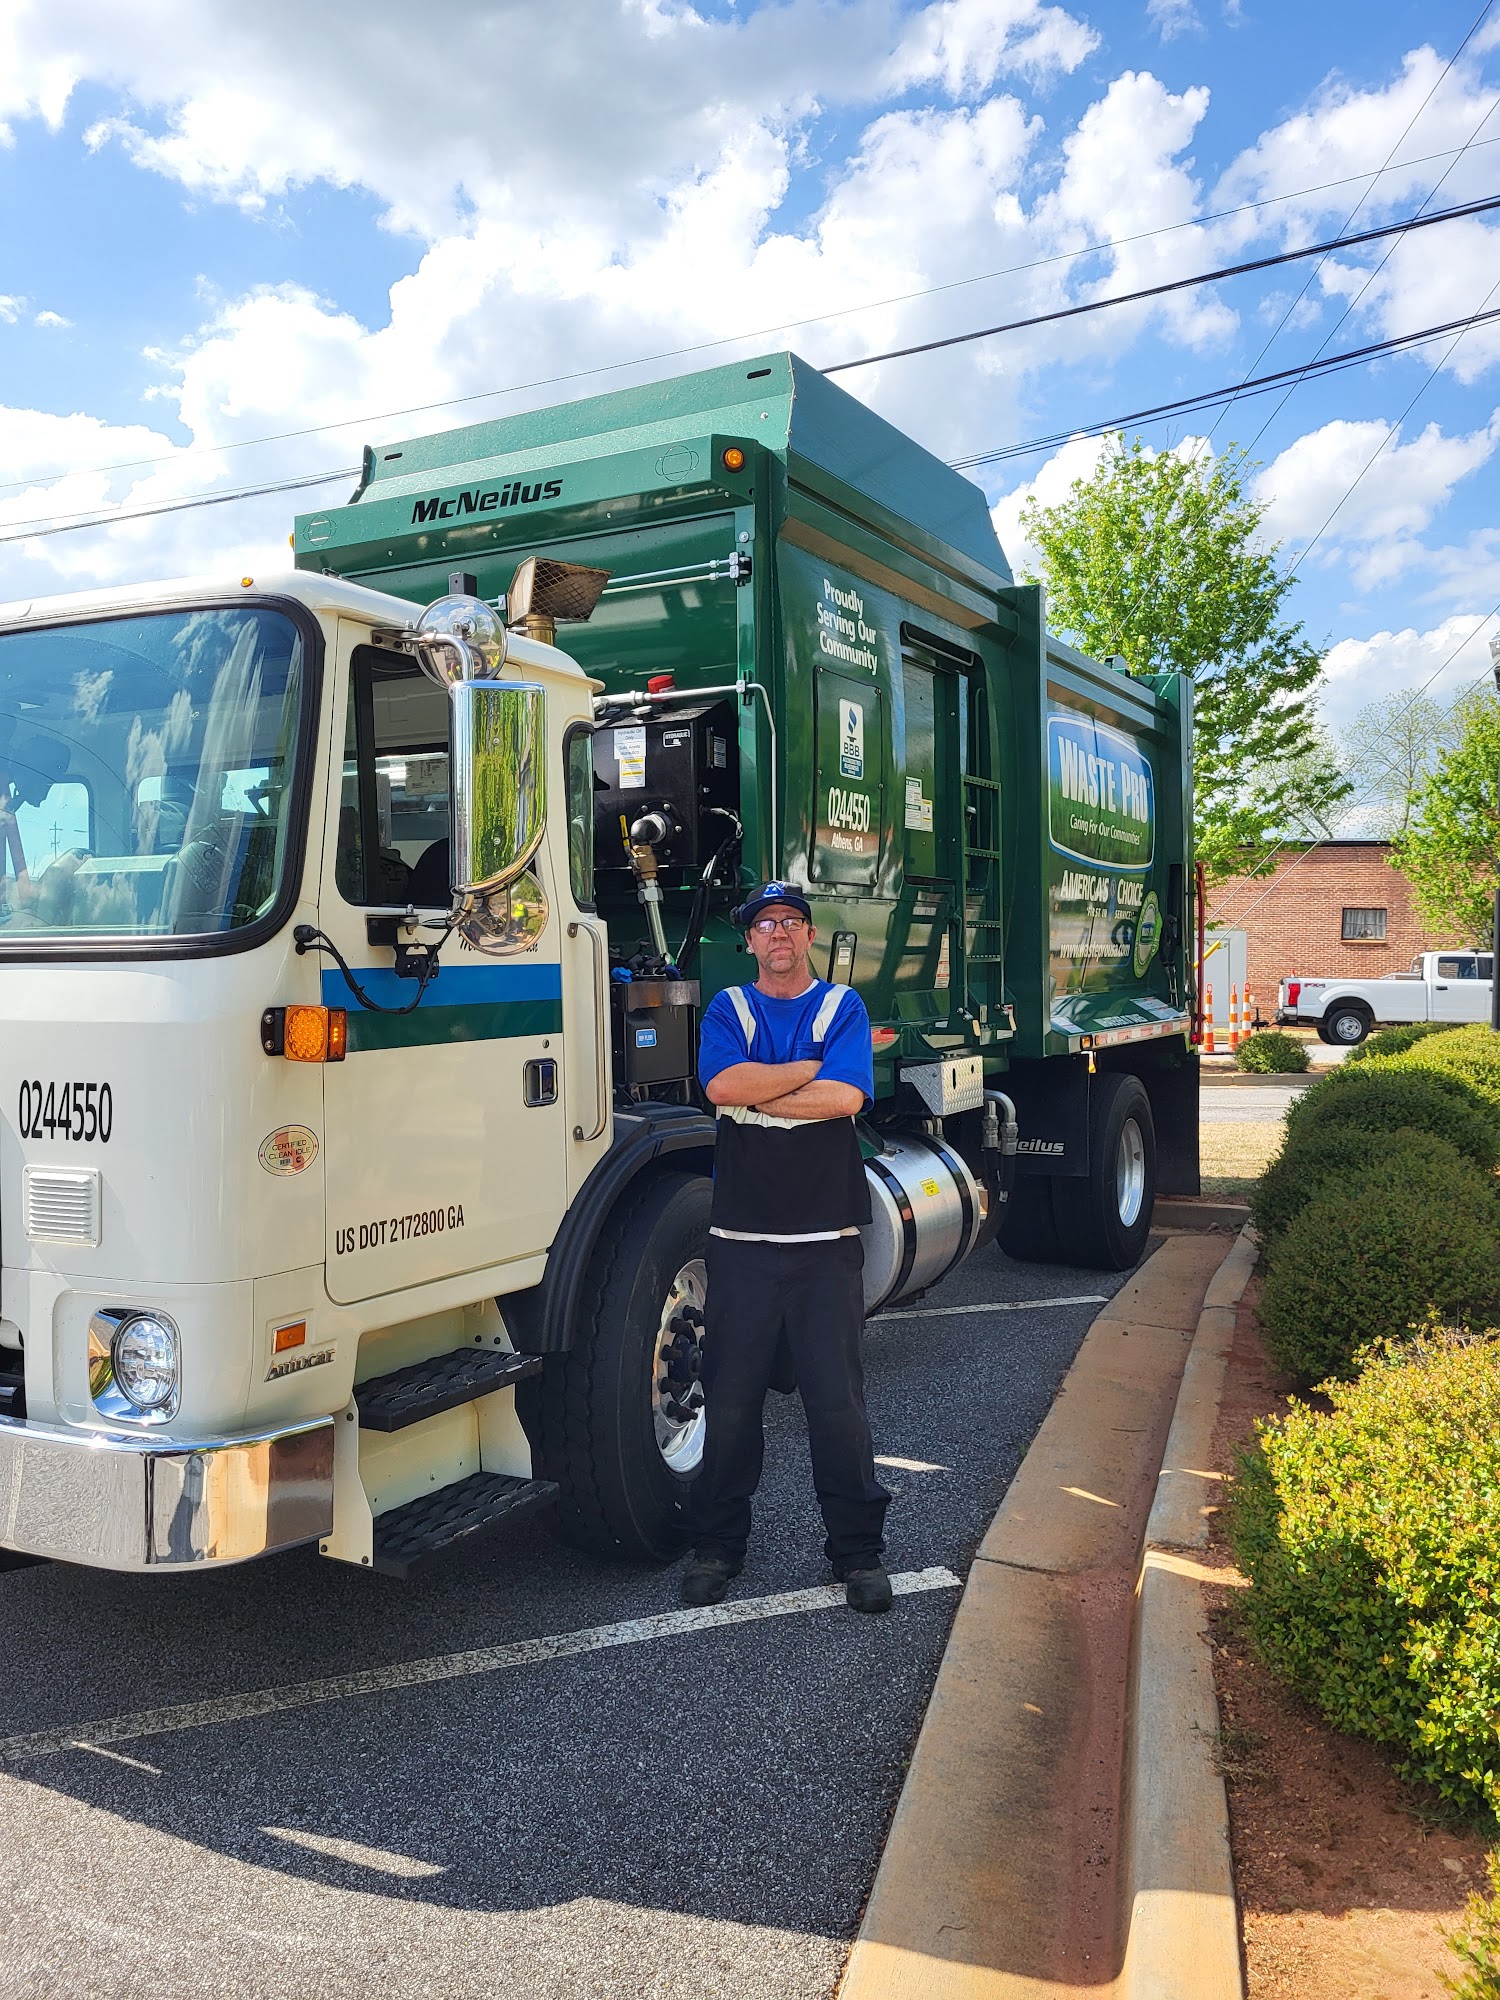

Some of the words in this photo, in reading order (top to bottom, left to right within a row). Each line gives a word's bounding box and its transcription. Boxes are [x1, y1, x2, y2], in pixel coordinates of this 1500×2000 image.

[411, 478, 563, 524] McNeilus
[823, 578, 863, 619] Proudly
[816, 602, 856, 642] Serving
[858, 620, 877, 645] Our
[820, 631, 878, 676] Community
[843, 741, 860, 757] BBB
[1058, 735, 1117, 814] WASTE
[1120, 761, 1149, 824] PRO
[828, 786, 870, 833] 0244550
[1070, 813, 1089, 836] Caring
[1089, 819, 1098, 834] For
[1098, 822, 1110, 836] Our
[831, 832, 853, 852] Athens,
[854, 836, 863, 852] GA
[1060, 869, 1110, 903] AMERICA'S
[1116, 879, 1144, 907] CHOICE
[19, 1079, 113, 1143] 0244550
[268, 1150, 293, 1160] CLEAN
[296, 1146, 311, 1156] IDLE
[271, 1139, 307, 1151] CERTIFIED
[336, 1226, 355, 1255] US
[360, 1219, 387, 1250] DOT
[390, 1208, 445, 1243] 2172800
[448, 1204, 465, 1230] GA
[264, 1348, 336, 1383] Autocar
